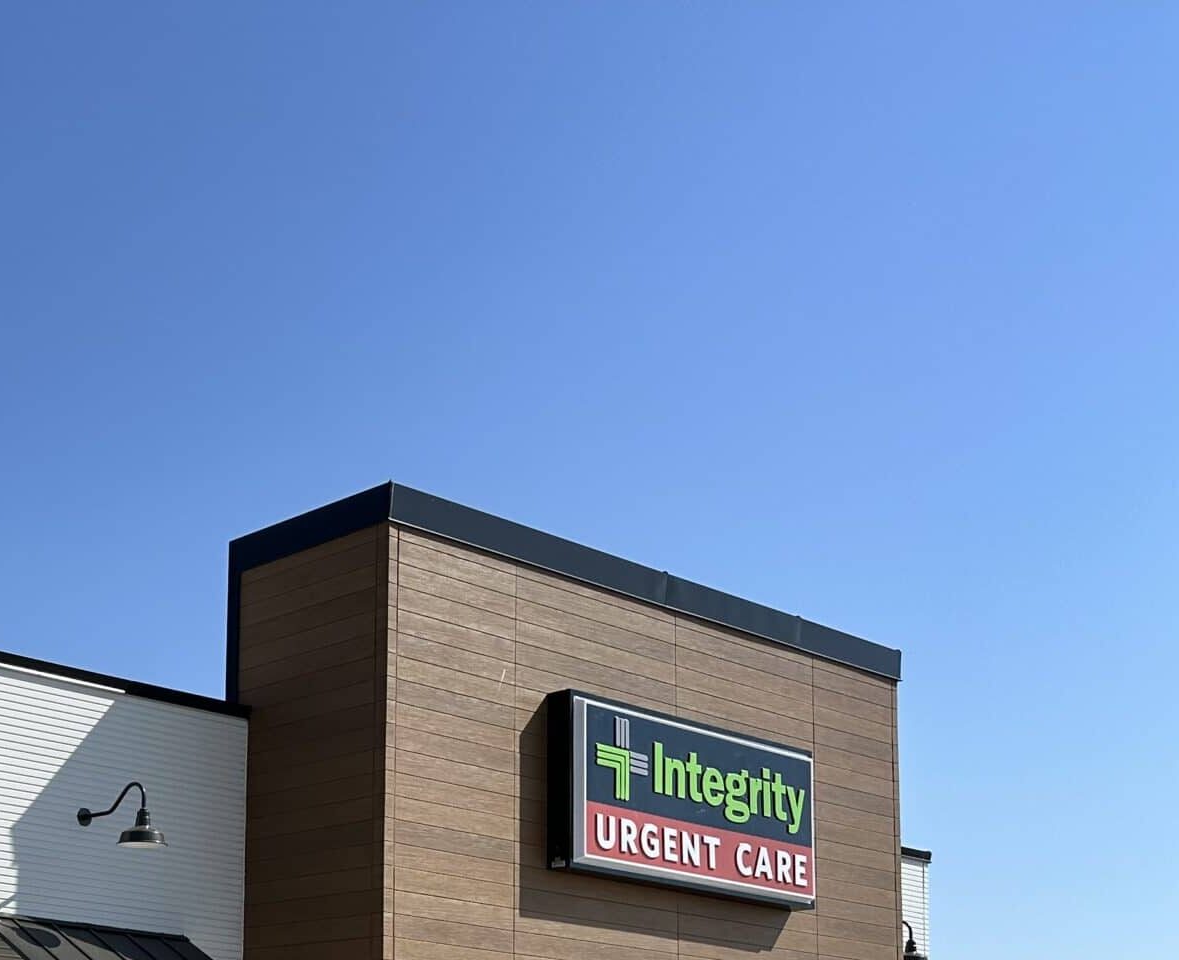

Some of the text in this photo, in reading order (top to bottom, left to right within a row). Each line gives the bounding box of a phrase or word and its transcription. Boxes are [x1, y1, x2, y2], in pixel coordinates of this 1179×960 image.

[653, 741, 805, 834] Integrity
[596, 813, 808, 887] URGENT CARE
